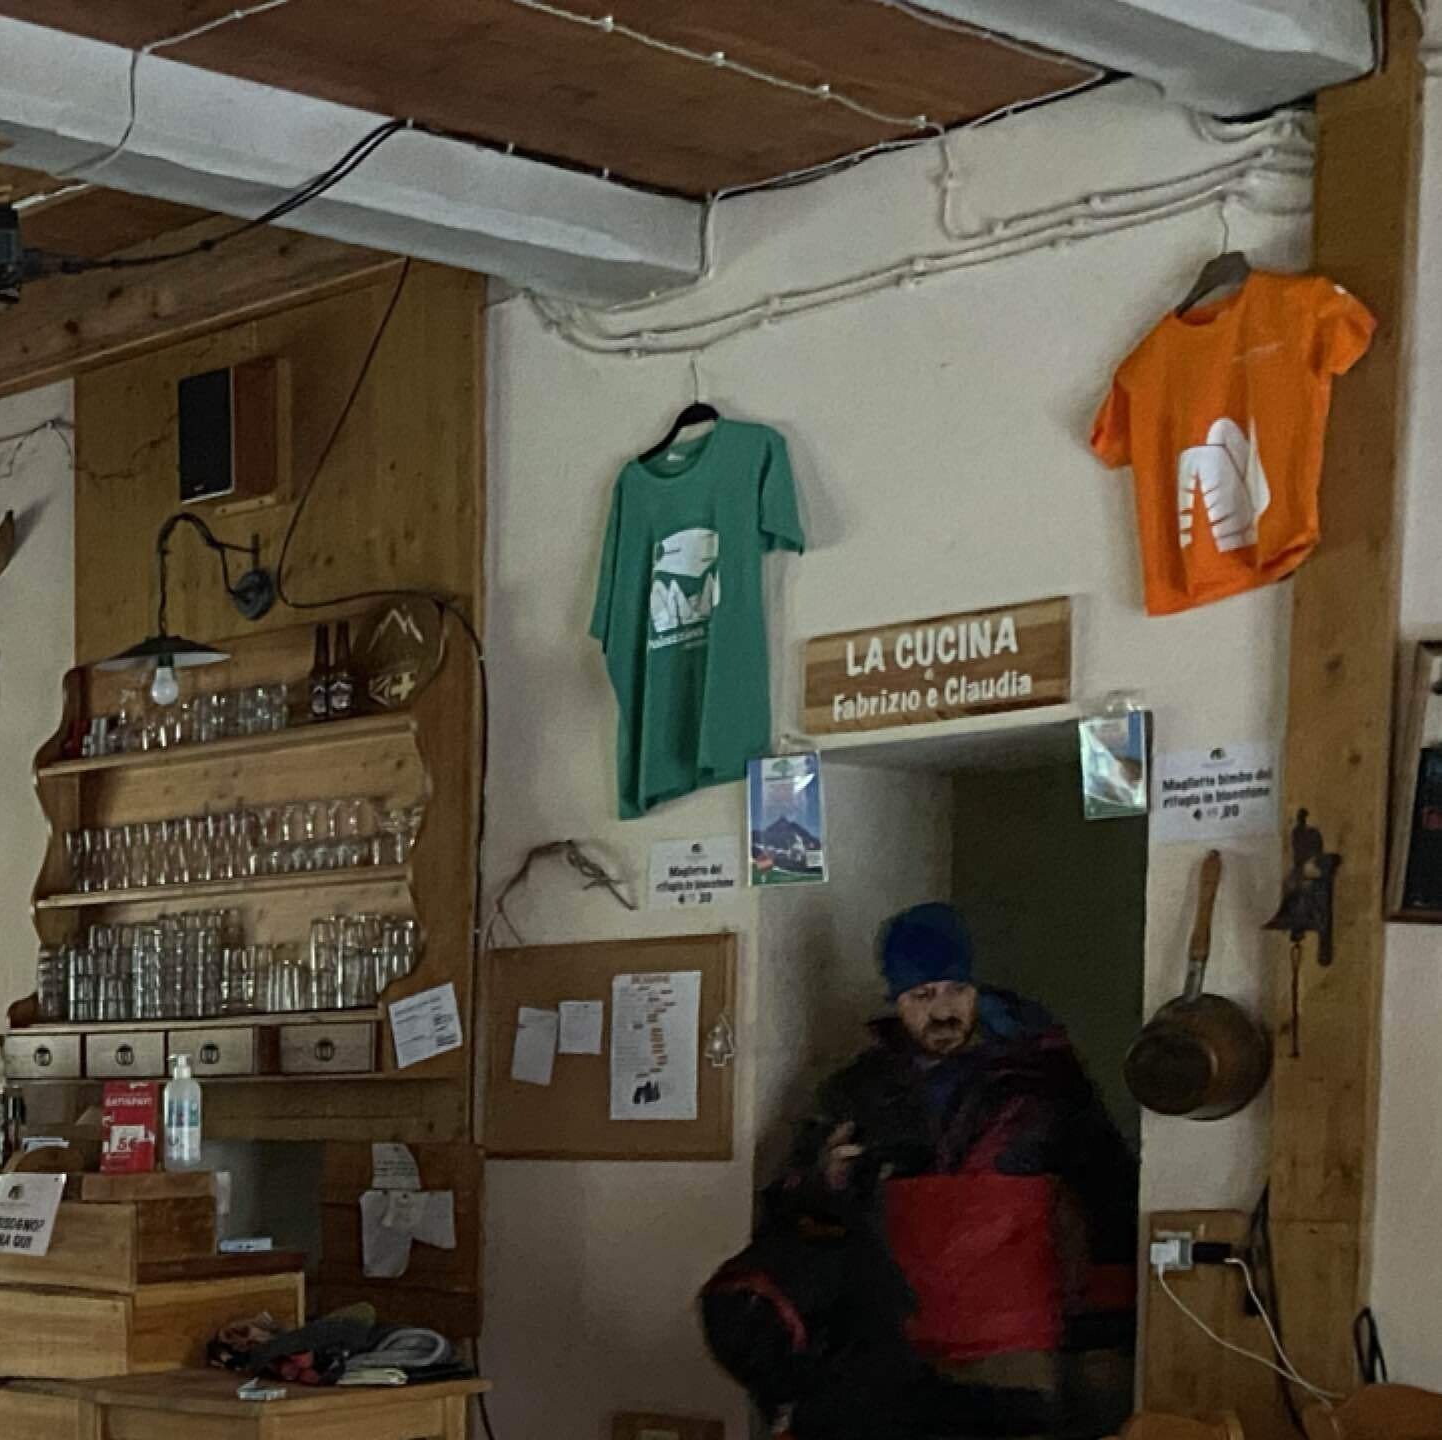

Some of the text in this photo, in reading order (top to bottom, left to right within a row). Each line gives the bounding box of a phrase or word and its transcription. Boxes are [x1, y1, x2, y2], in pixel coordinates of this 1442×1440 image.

[845, 615, 1019, 677] LA CUCINA
[832, 670, 1033, 722] Fabrizio e Claudia
